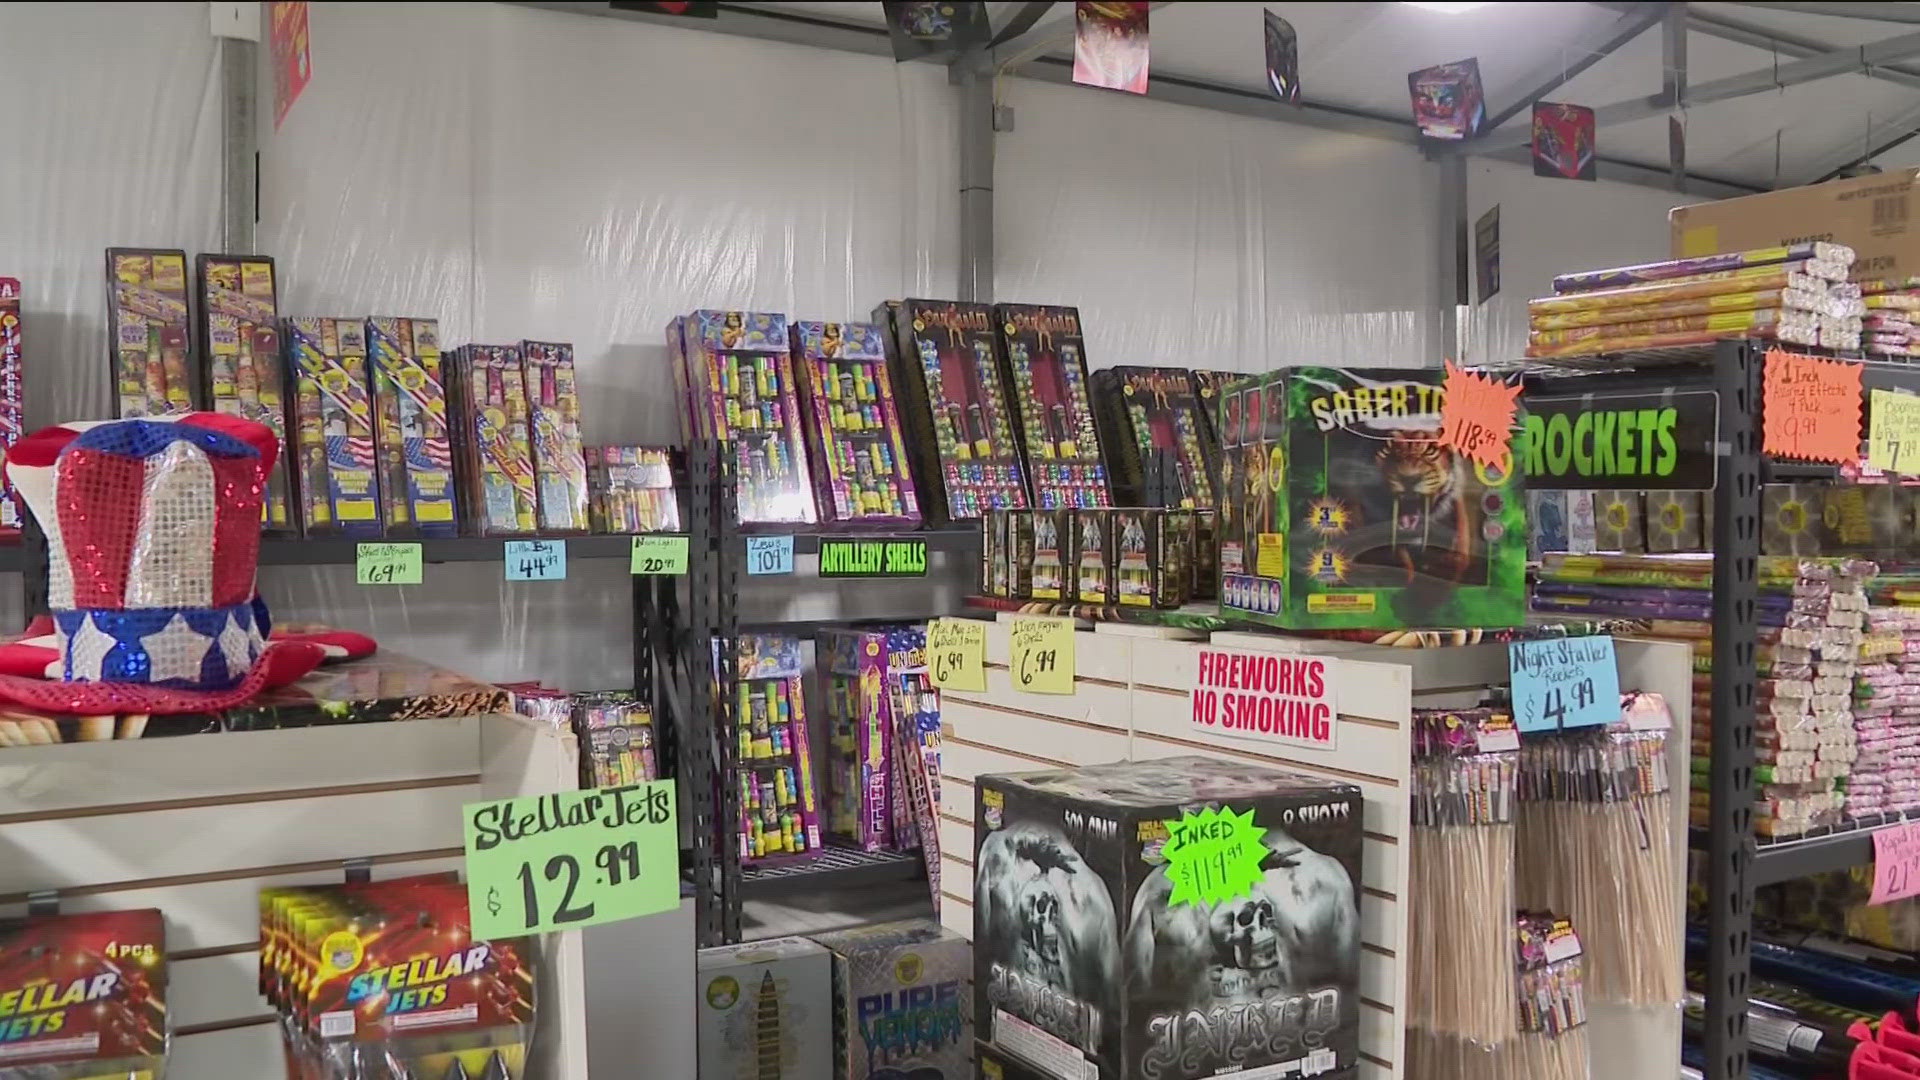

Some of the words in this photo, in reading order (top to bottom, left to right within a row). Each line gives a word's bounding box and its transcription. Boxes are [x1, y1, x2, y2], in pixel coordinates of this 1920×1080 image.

[1312, 385, 1408, 432] SABER
[1524, 407, 1677, 477] ROCKETS
[820, 542, 883, 573] ARTILLERY
[885, 542, 926, 573] SHELLS
[1198, 651, 1325, 698] FIREWORKS
[1513, 642, 1554, 678] Night
[1193, 689, 1217, 726] NO
[1222, 692, 1331, 742] SMOKING
[473, 793, 603, 851] Stellar
[600, 784, 671, 829] Jets
[1173, 820, 1234, 852] INKED
[105, 940, 117, 958] 4
[119, 944, 154, 958] PCS
[346, 944, 490, 1002] STELLAR
[385, 982, 448, 1016] JETS
